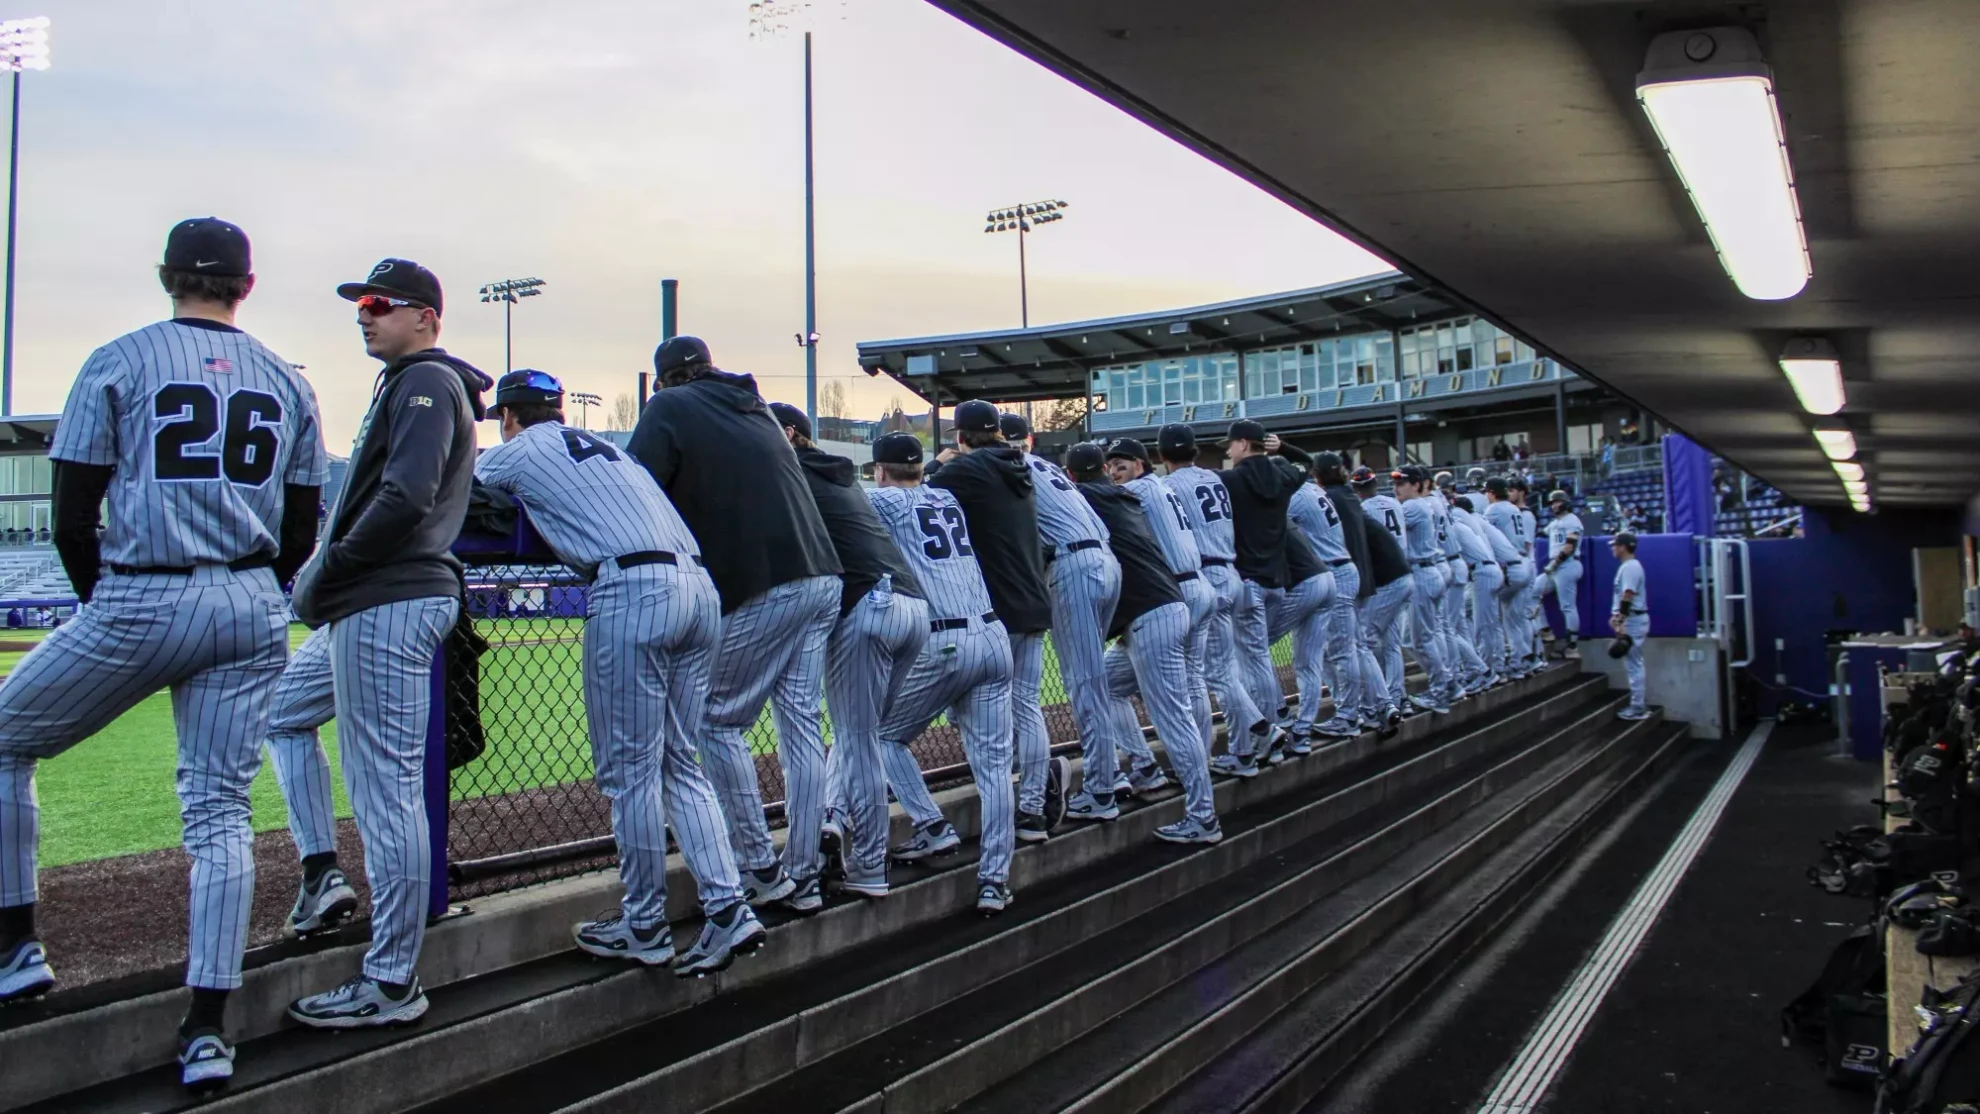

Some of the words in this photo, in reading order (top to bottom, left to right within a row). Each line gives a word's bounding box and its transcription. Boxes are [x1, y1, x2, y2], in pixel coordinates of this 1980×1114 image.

[1143, 402, 1236, 425] THE
[1295, 362, 1544, 410] DIAMOND
[152, 381, 283, 489] 26
[1194, 483, 1232, 523] 28
[913, 506, 975, 561] 52
[198, 1048, 217, 1059] NIKE
[1841, 1043, 1880, 1064] P
